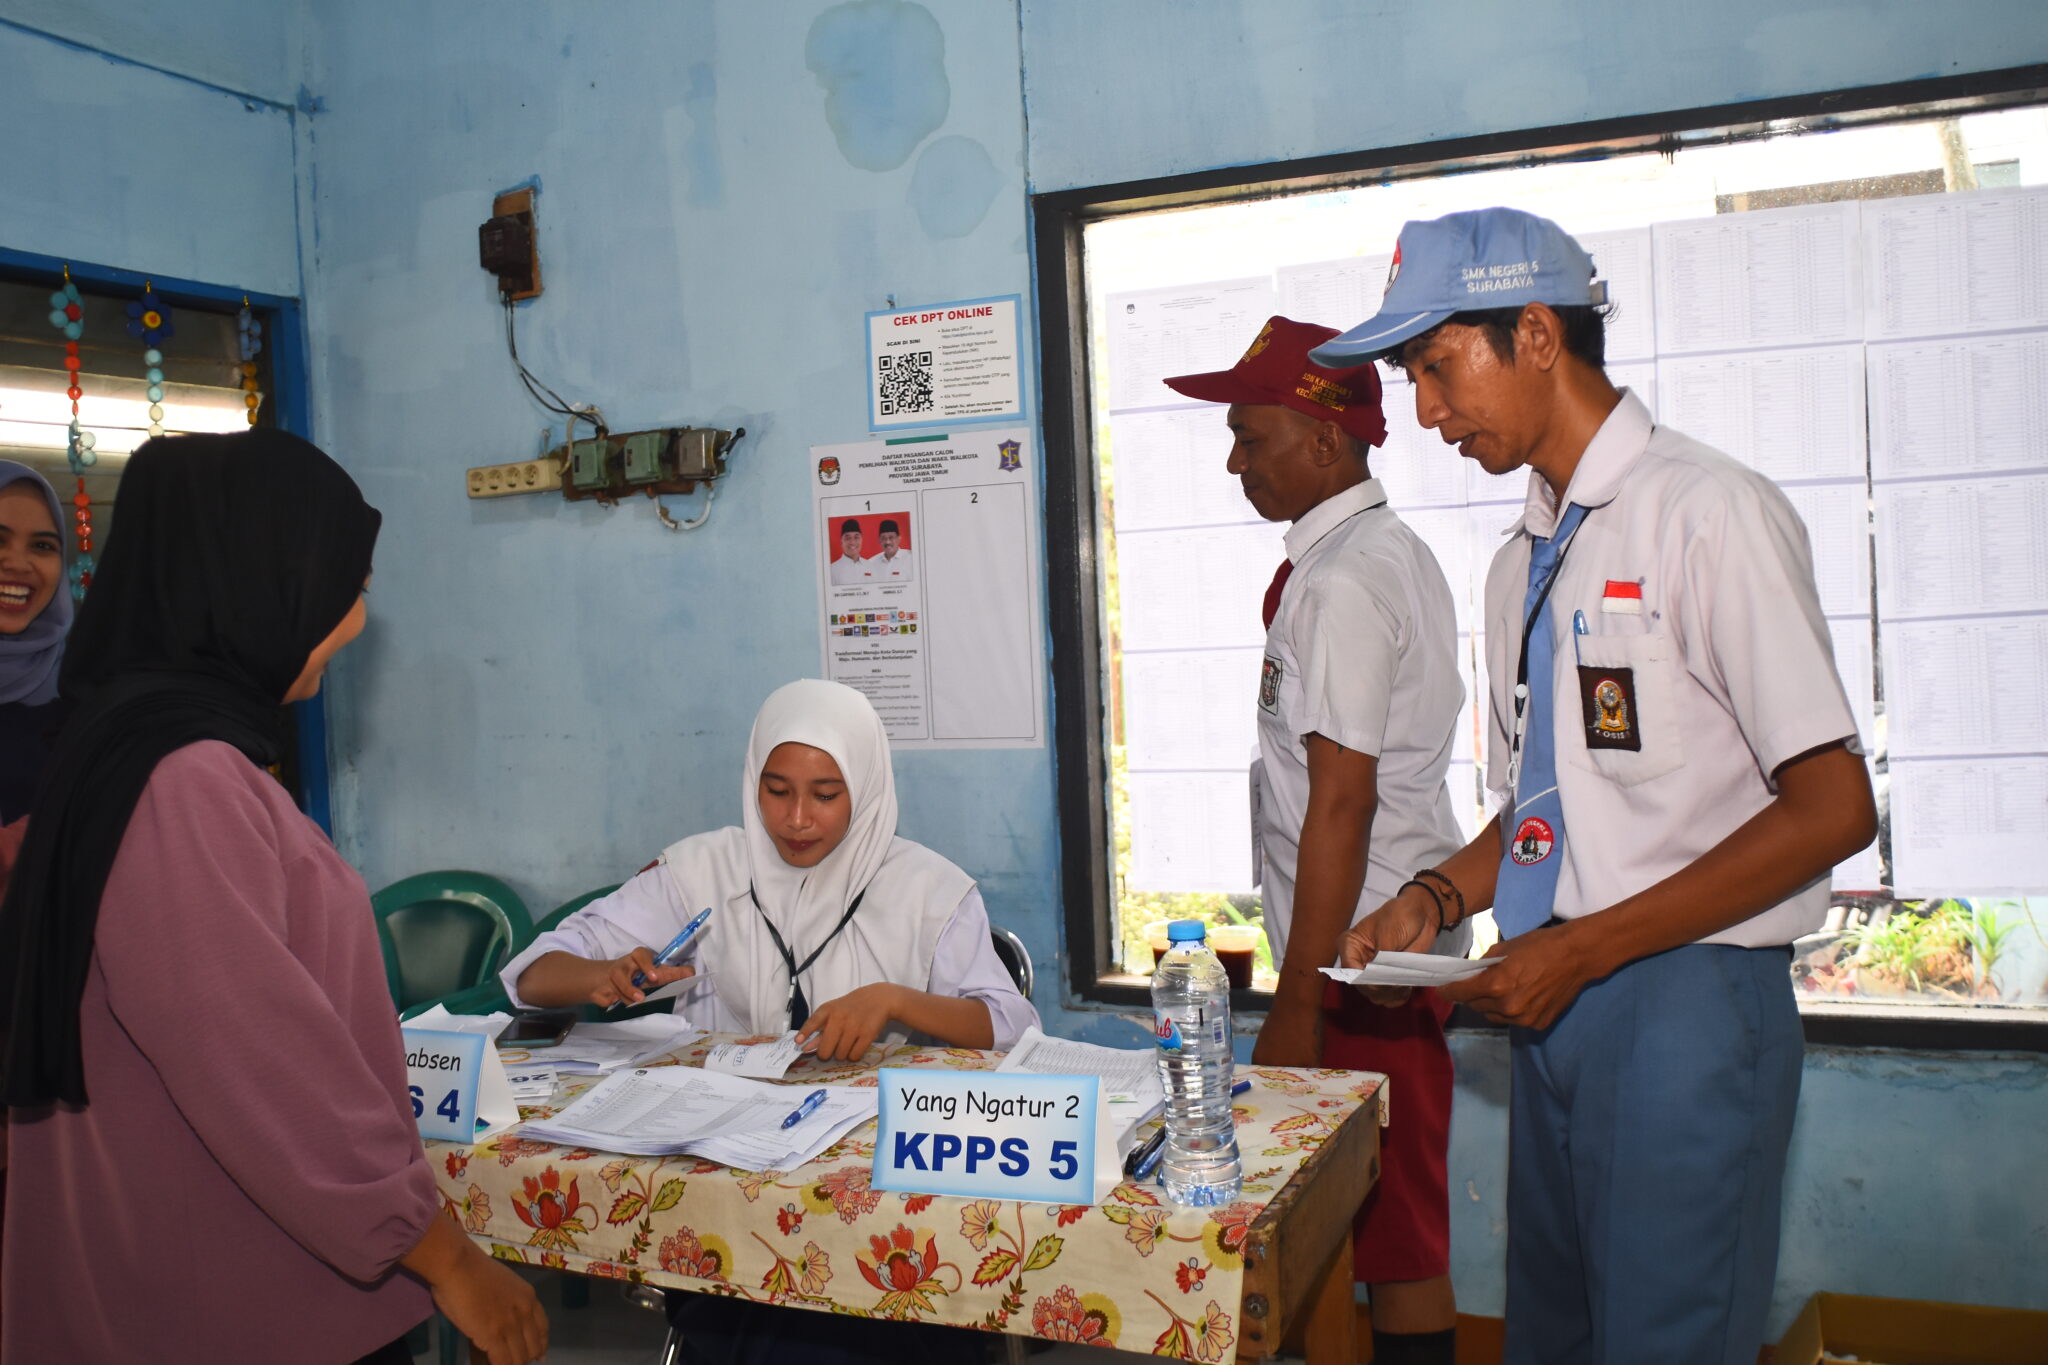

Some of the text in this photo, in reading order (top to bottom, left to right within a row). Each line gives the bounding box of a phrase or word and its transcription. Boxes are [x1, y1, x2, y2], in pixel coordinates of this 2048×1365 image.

[1461, 260, 1539, 280] SMK NEGERI 5
[1466, 275, 1535, 294] SURABAYA
[893, 306, 993, 326] CEK DPT ONLINE
[889, 458, 917, 466] WALIKOTA
[931, 455, 949, 463] WAKIL
[950, 453, 979, 461] WALIKOTA
[904, 451, 934, 459] PASANGAN
[911, 463, 943, 471] SURABAYA
[865, 500, 871, 511] 1
[970, 492, 979, 504] 2
[406, 1047, 461, 1072] absen
[408, 1085, 460, 1123] S 4
[901, 1087, 1080, 1122] Yang Ngatur 2
[893, 1131, 1079, 1180] KPPS 5
